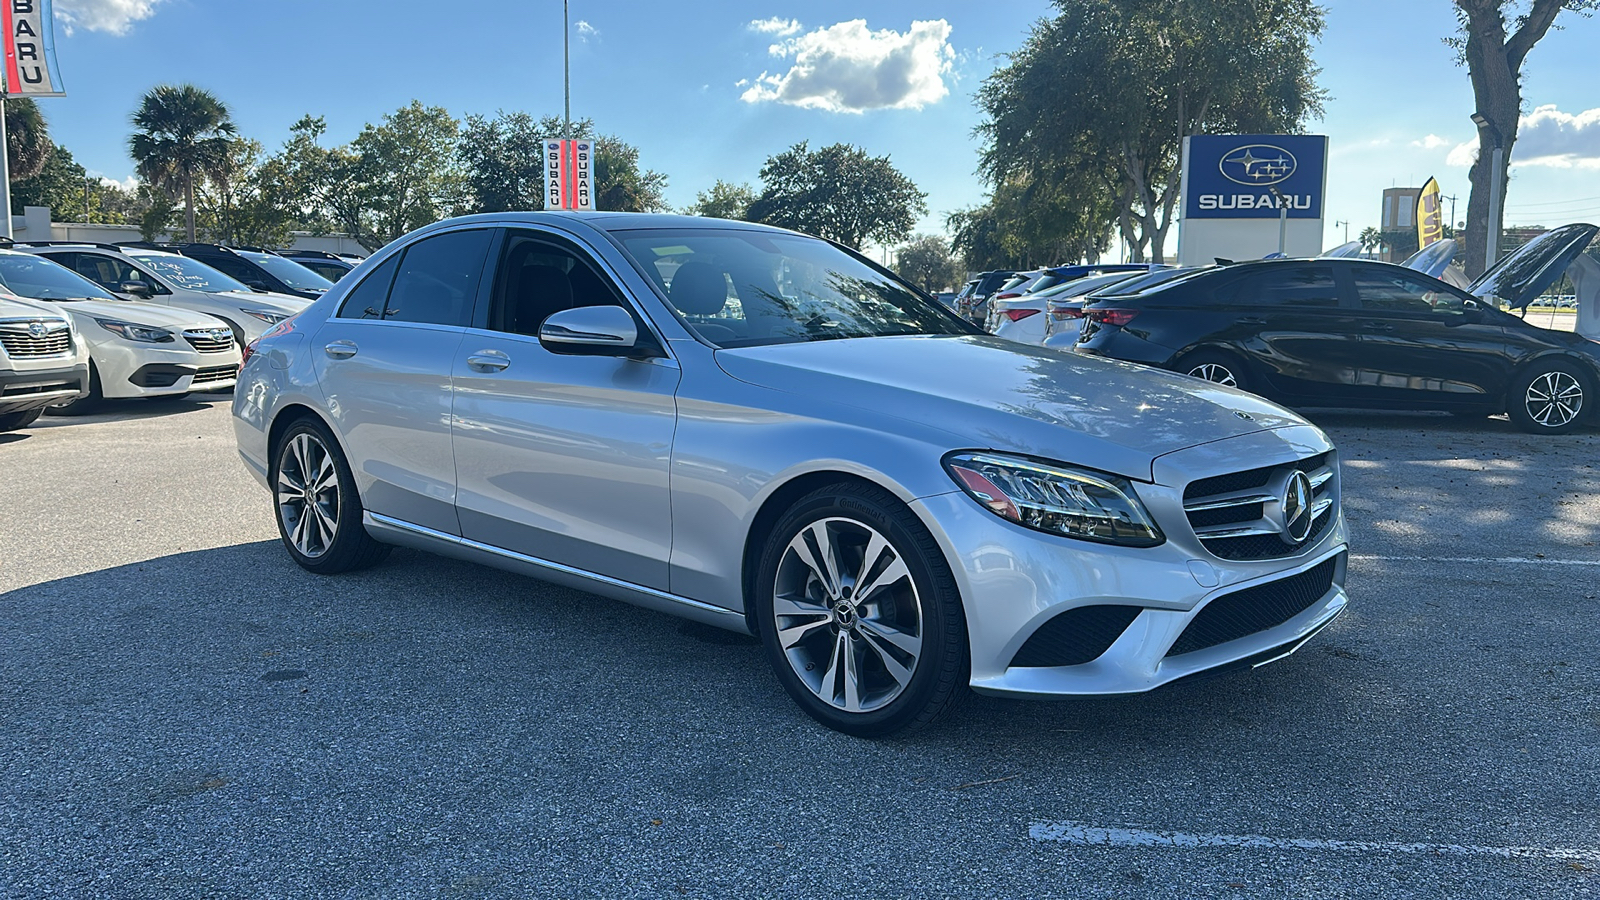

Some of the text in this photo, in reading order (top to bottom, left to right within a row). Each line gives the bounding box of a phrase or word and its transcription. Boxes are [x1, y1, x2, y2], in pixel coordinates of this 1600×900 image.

[549, 153, 559, 205] SUBARU
[578, 153, 588, 206] SUBARU
[1199, 194, 1311, 210] SUBARU
[839, 498, 881, 520] Continental
